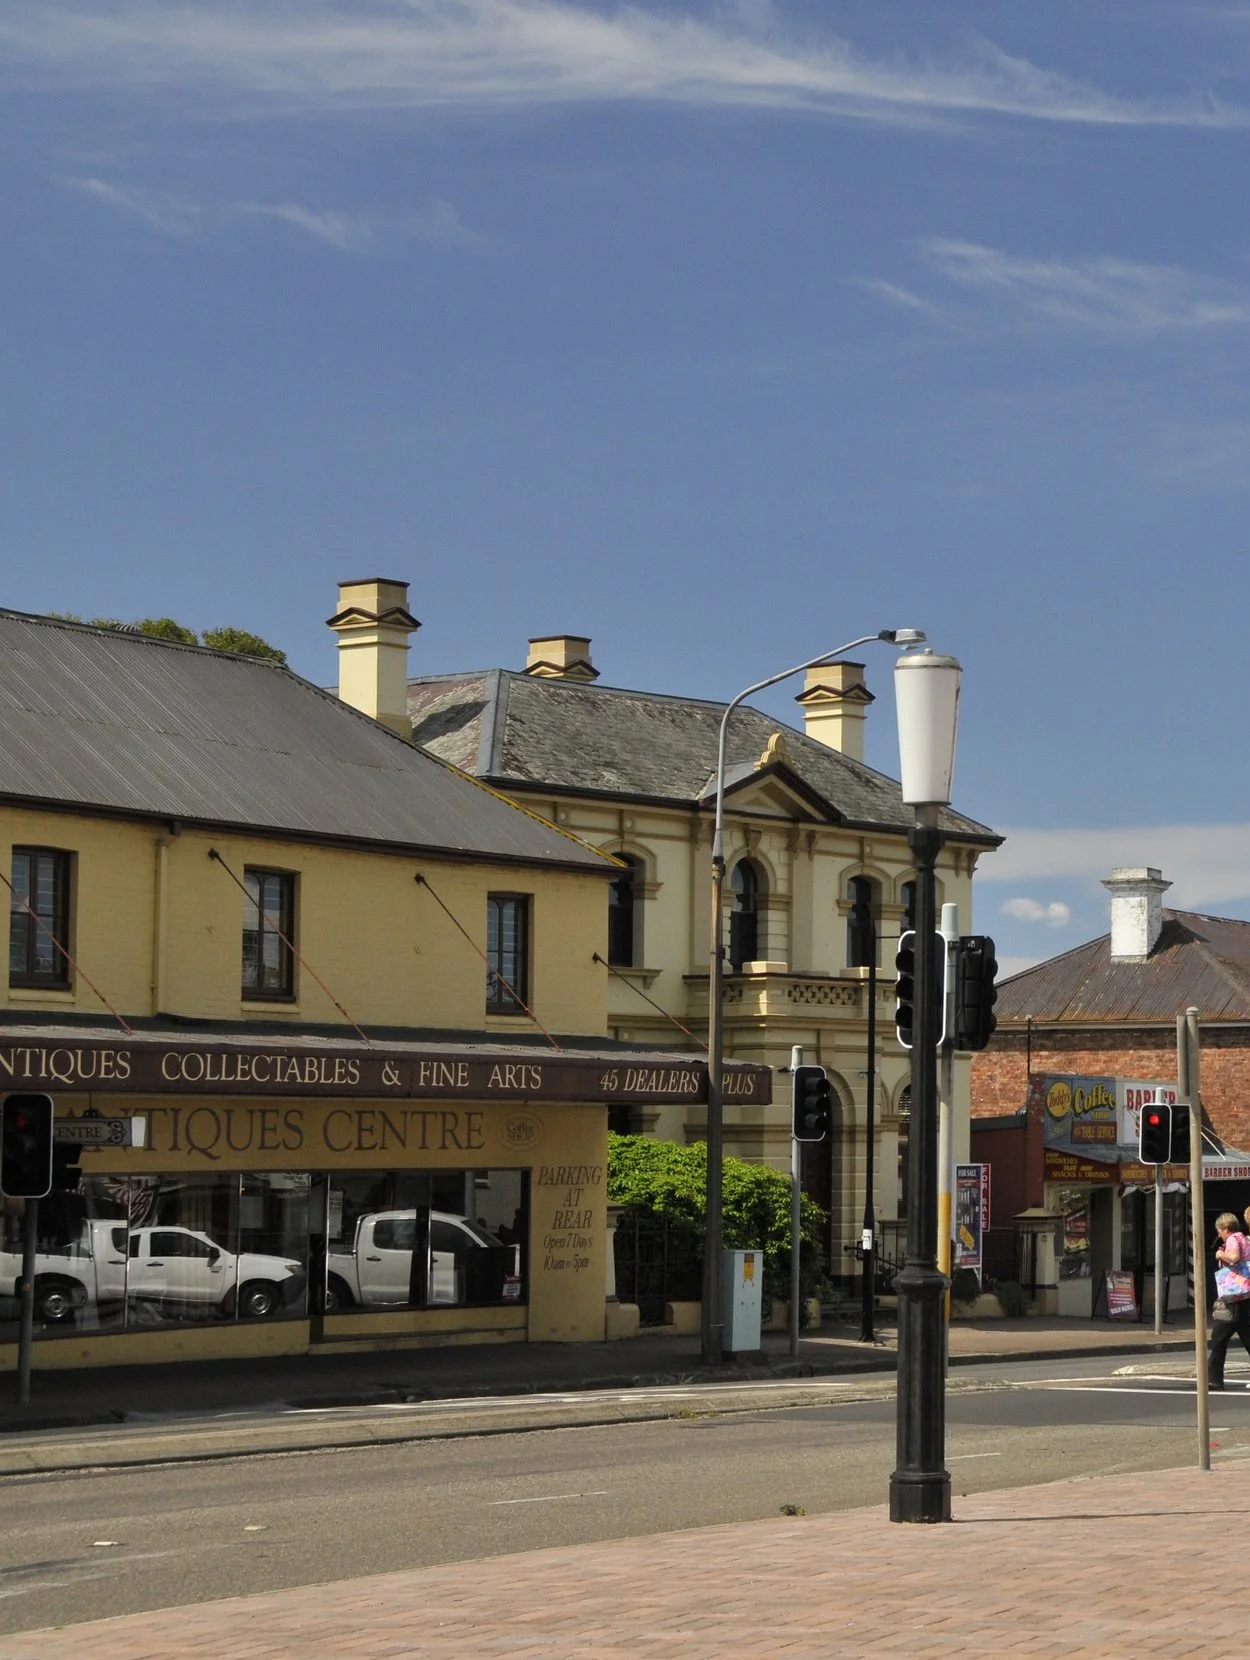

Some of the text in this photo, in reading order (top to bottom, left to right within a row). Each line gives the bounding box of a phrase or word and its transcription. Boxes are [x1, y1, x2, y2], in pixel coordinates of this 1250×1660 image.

[0, 1047, 542, 1090] NTIQUES COLLECTABLES & FINE ARTS
[600, 1068, 755, 1095] 45 DEALERS PLUS
[1073, 1083, 1116, 1115] Coffee
[1126, 1088, 1176, 1111] BARR
[1091, 1111, 1111, 1120] SHOP
[54, 1126, 102, 1138] ENTRE
[62, 1106, 485, 1160] TIQUES CENTRE
[537, 1166, 603, 1186] PARKING
[957, 1168, 977, 1177] FOR SALE
[1204, 1167, 1232, 1178] BARBER
[562, 1188, 585, 1208] AT
[552, 1210, 593, 1230] REAR
[543, 1233, 594, 1253] Open 7 Days
[543, 1256, 565, 1271] 10am
[571, 1253, 590, 1272] 5pm
